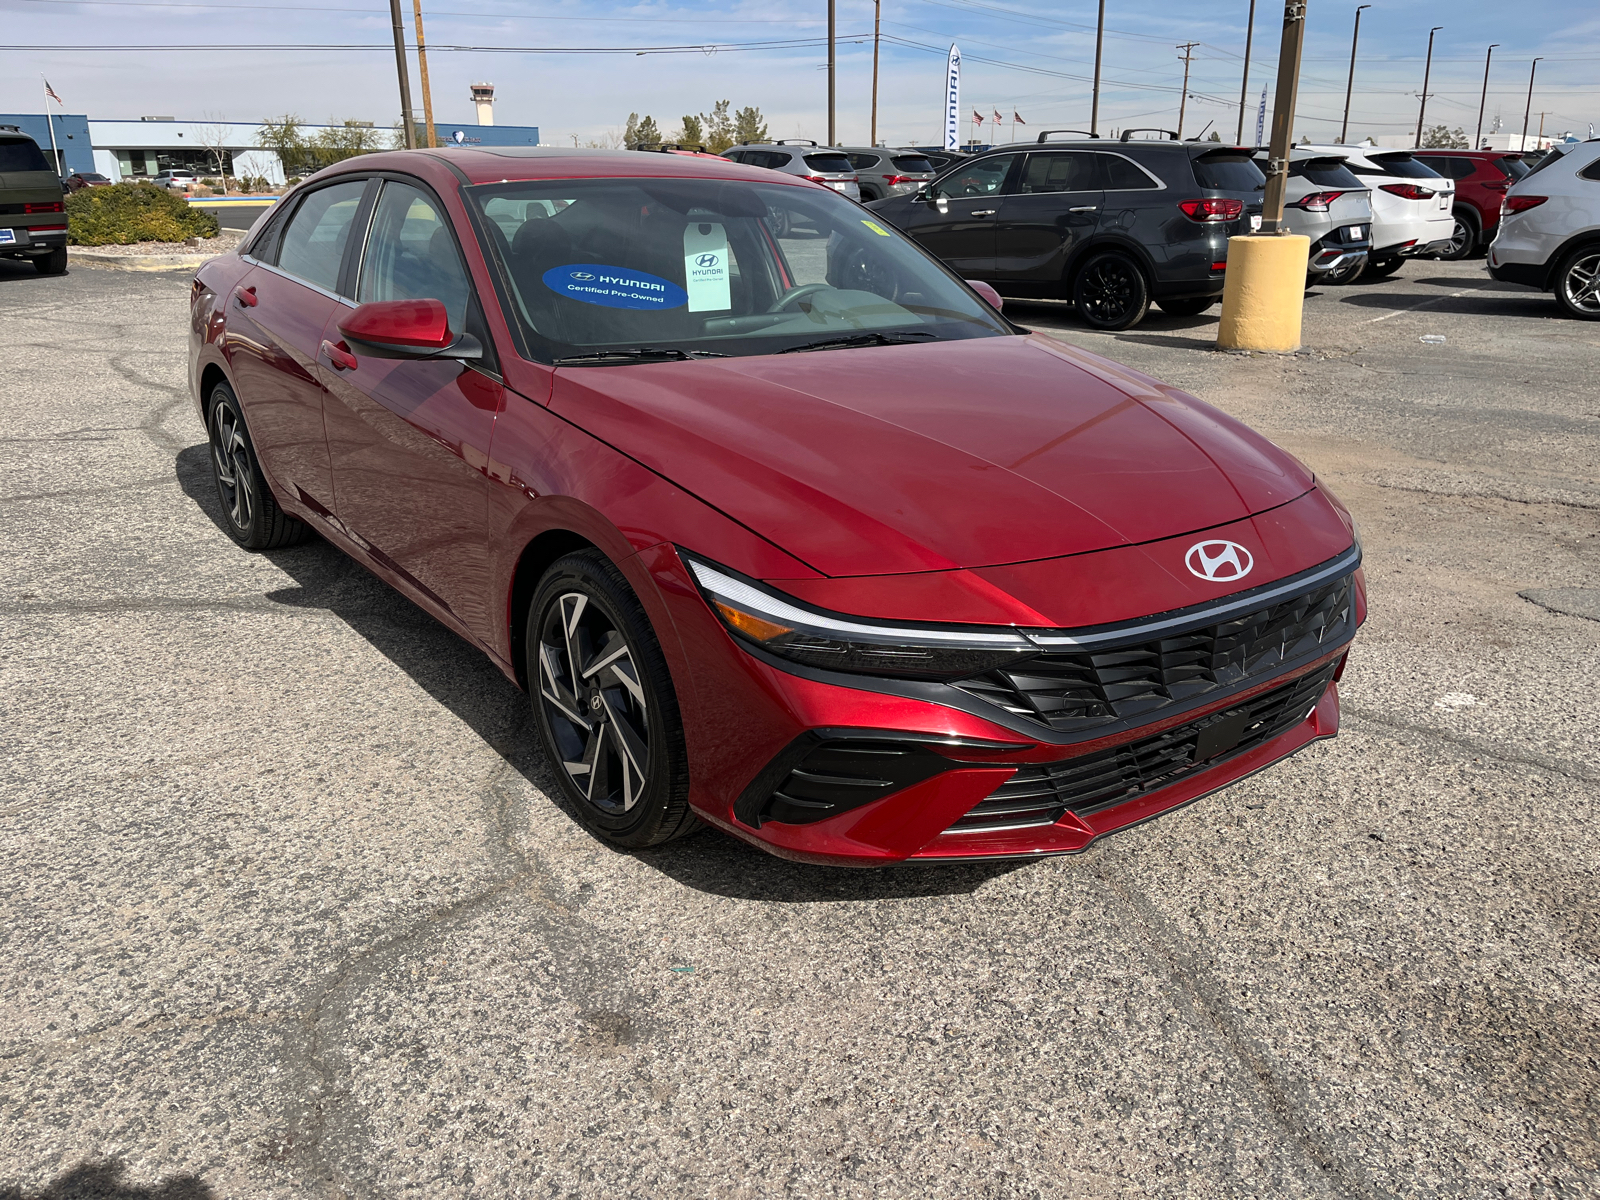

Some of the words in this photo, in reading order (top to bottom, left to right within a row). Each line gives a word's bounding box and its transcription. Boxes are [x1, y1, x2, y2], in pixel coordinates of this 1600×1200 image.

[949, 70, 958, 149] YUNDAI
[599, 275, 665, 292] HYUNDAI
[567, 284, 609, 295] Certified
[611, 290, 664, 303] Pre-Owned
